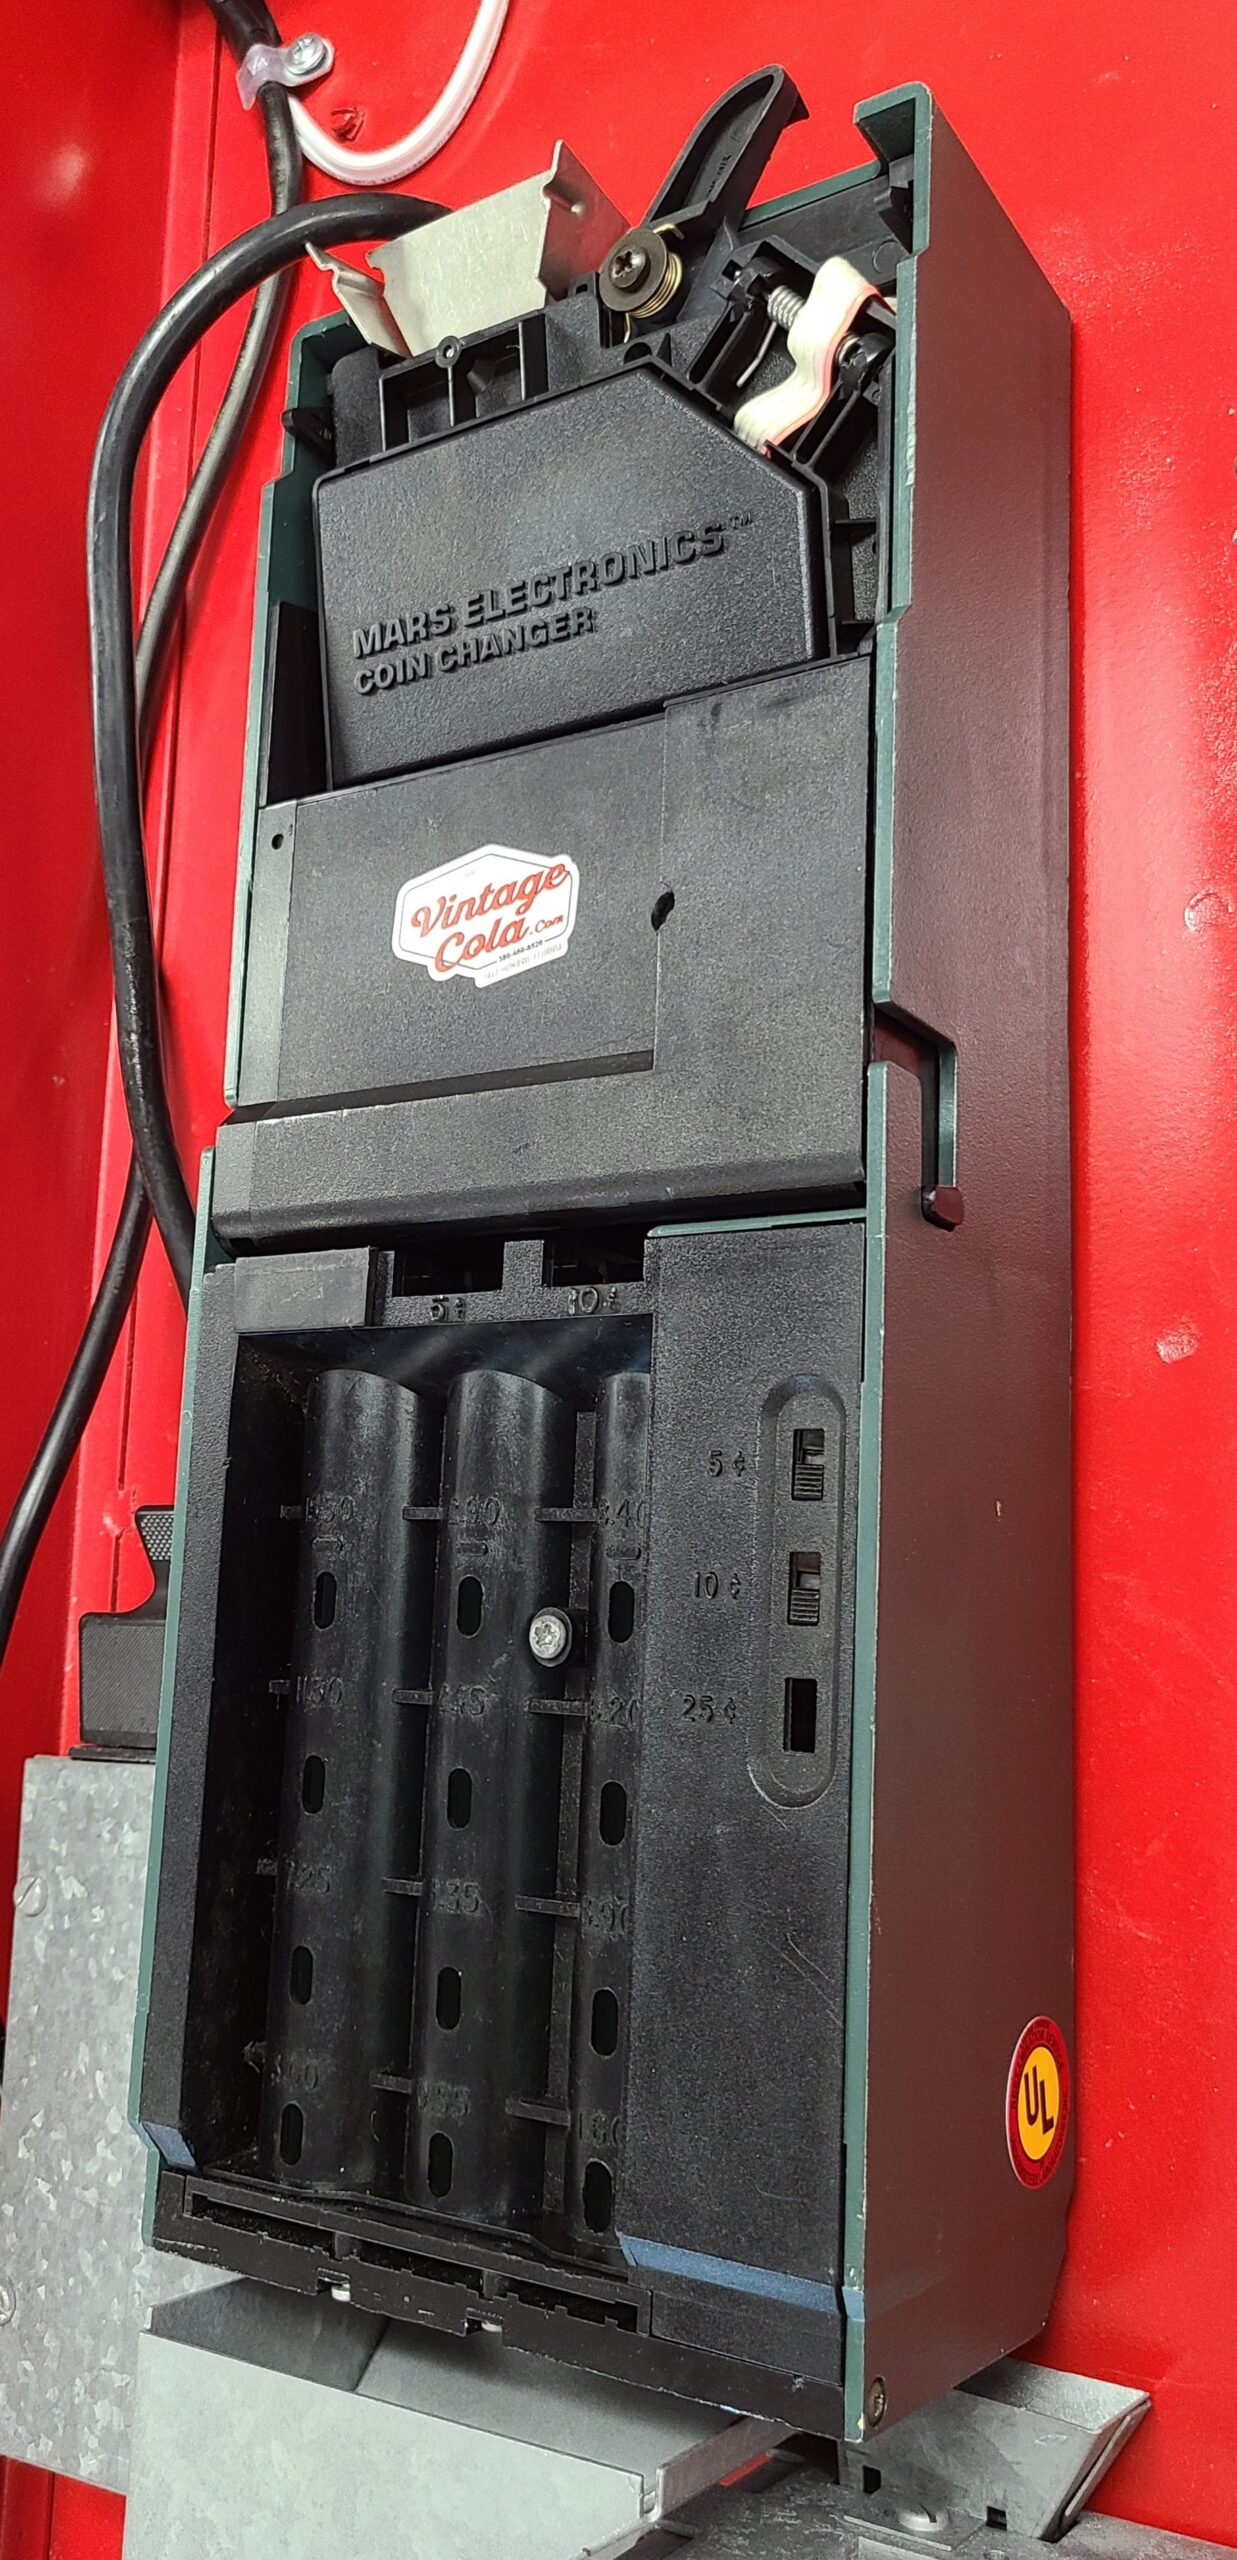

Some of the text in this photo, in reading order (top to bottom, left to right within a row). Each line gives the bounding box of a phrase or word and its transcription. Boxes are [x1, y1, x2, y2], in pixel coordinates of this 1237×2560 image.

[353, 604, 453, 658] MARS
[463, 520, 725, 628] ELECTRONICS
[354, 606, 598, 694] COIN CHANGER
[411, 863, 570, 938] Vintage
[434, 916, 529, 973] Cola
[1024, 2065, 1054, 2135] UL
